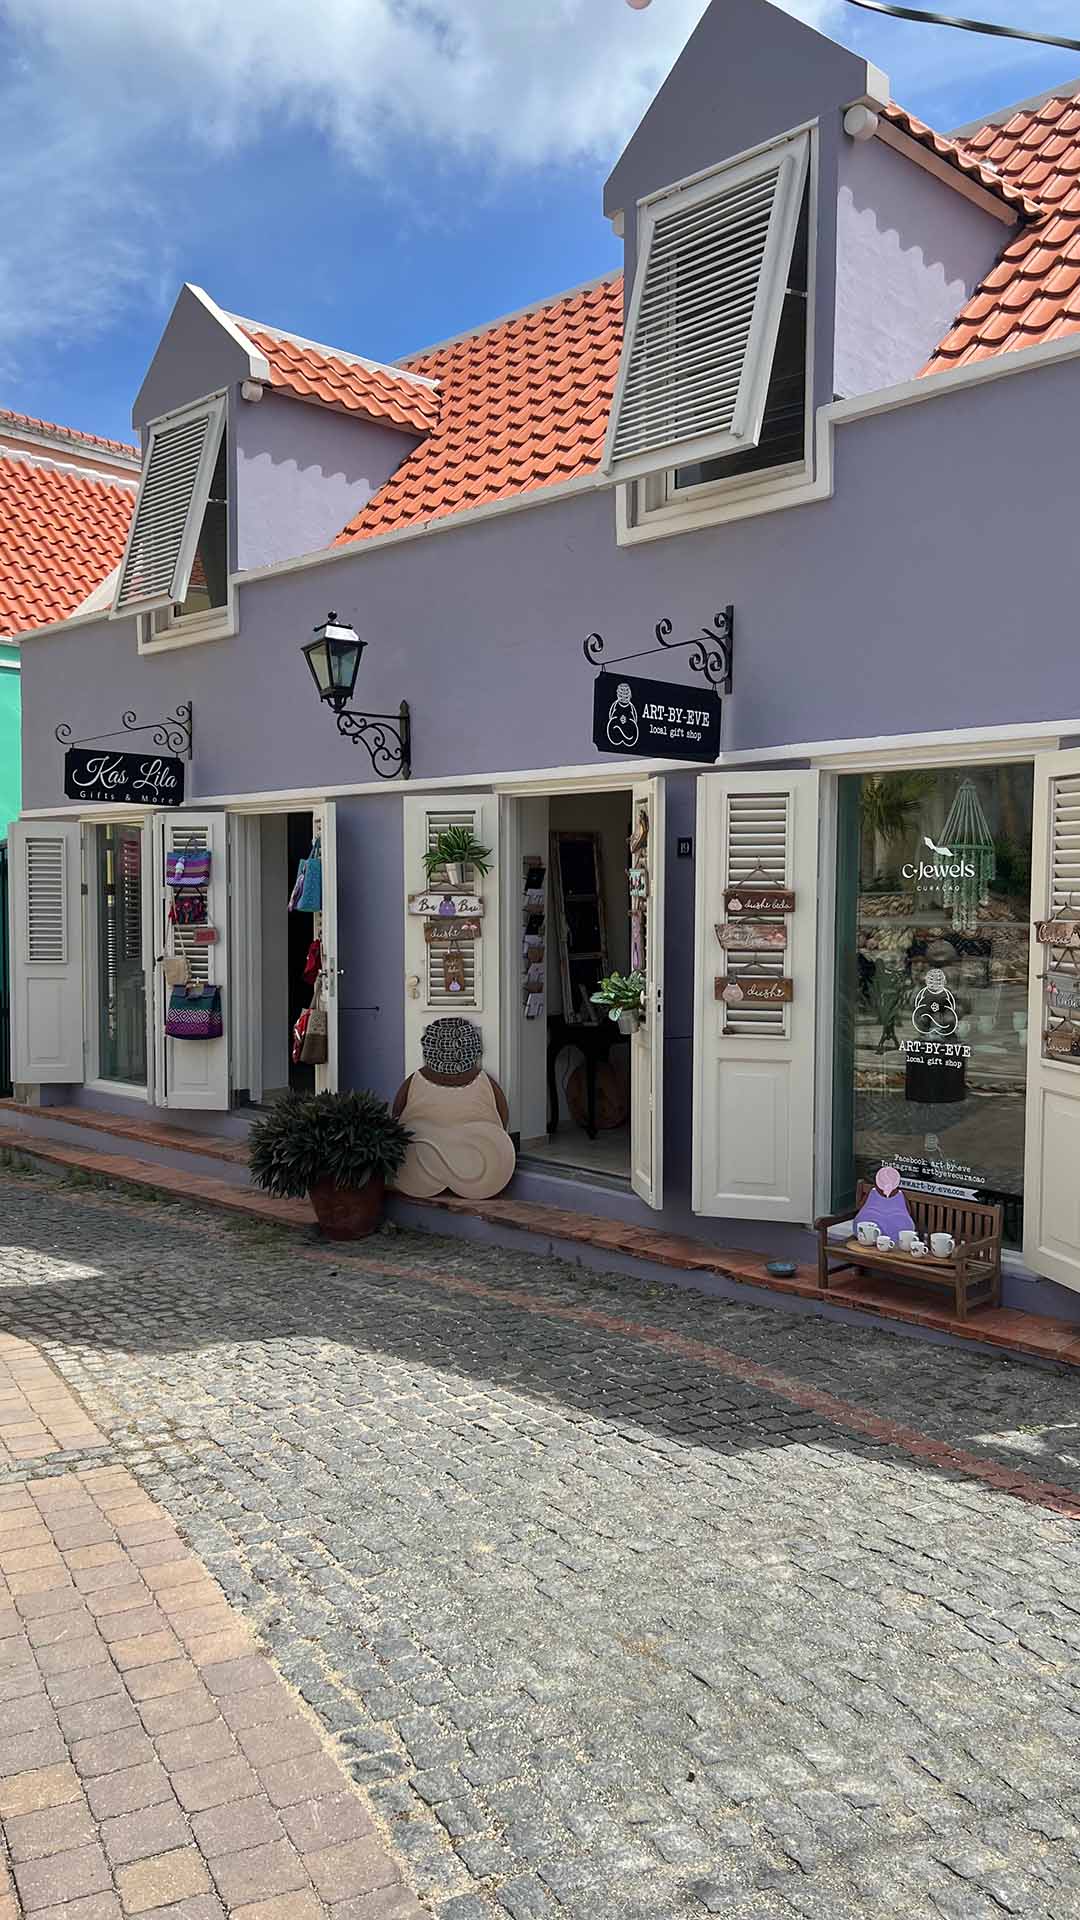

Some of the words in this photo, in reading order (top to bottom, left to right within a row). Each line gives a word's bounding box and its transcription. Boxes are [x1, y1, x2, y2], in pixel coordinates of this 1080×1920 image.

[642, 703, 710, 727] ART-BY-EVE
[649, 724, 667, 736] local
[669, 727, 685, 739] gift
[686, 730, 702, 742] shop
[72, 755, 129, 789] Kas
[132, 759, 177, 796] Lila
[80, 790, 115, 801] Gifts
[125, 793, 131, 801] &
[142, 795, 174, 804] More
[747, 983, 785, 998] dushi
[898, 1040, 971, 1057] ART-BY-EVE
[906, 1055, 925, 1064] local
[927, 1057, 943, 1066] gift
[945, 1059, 962, 1069] shop
